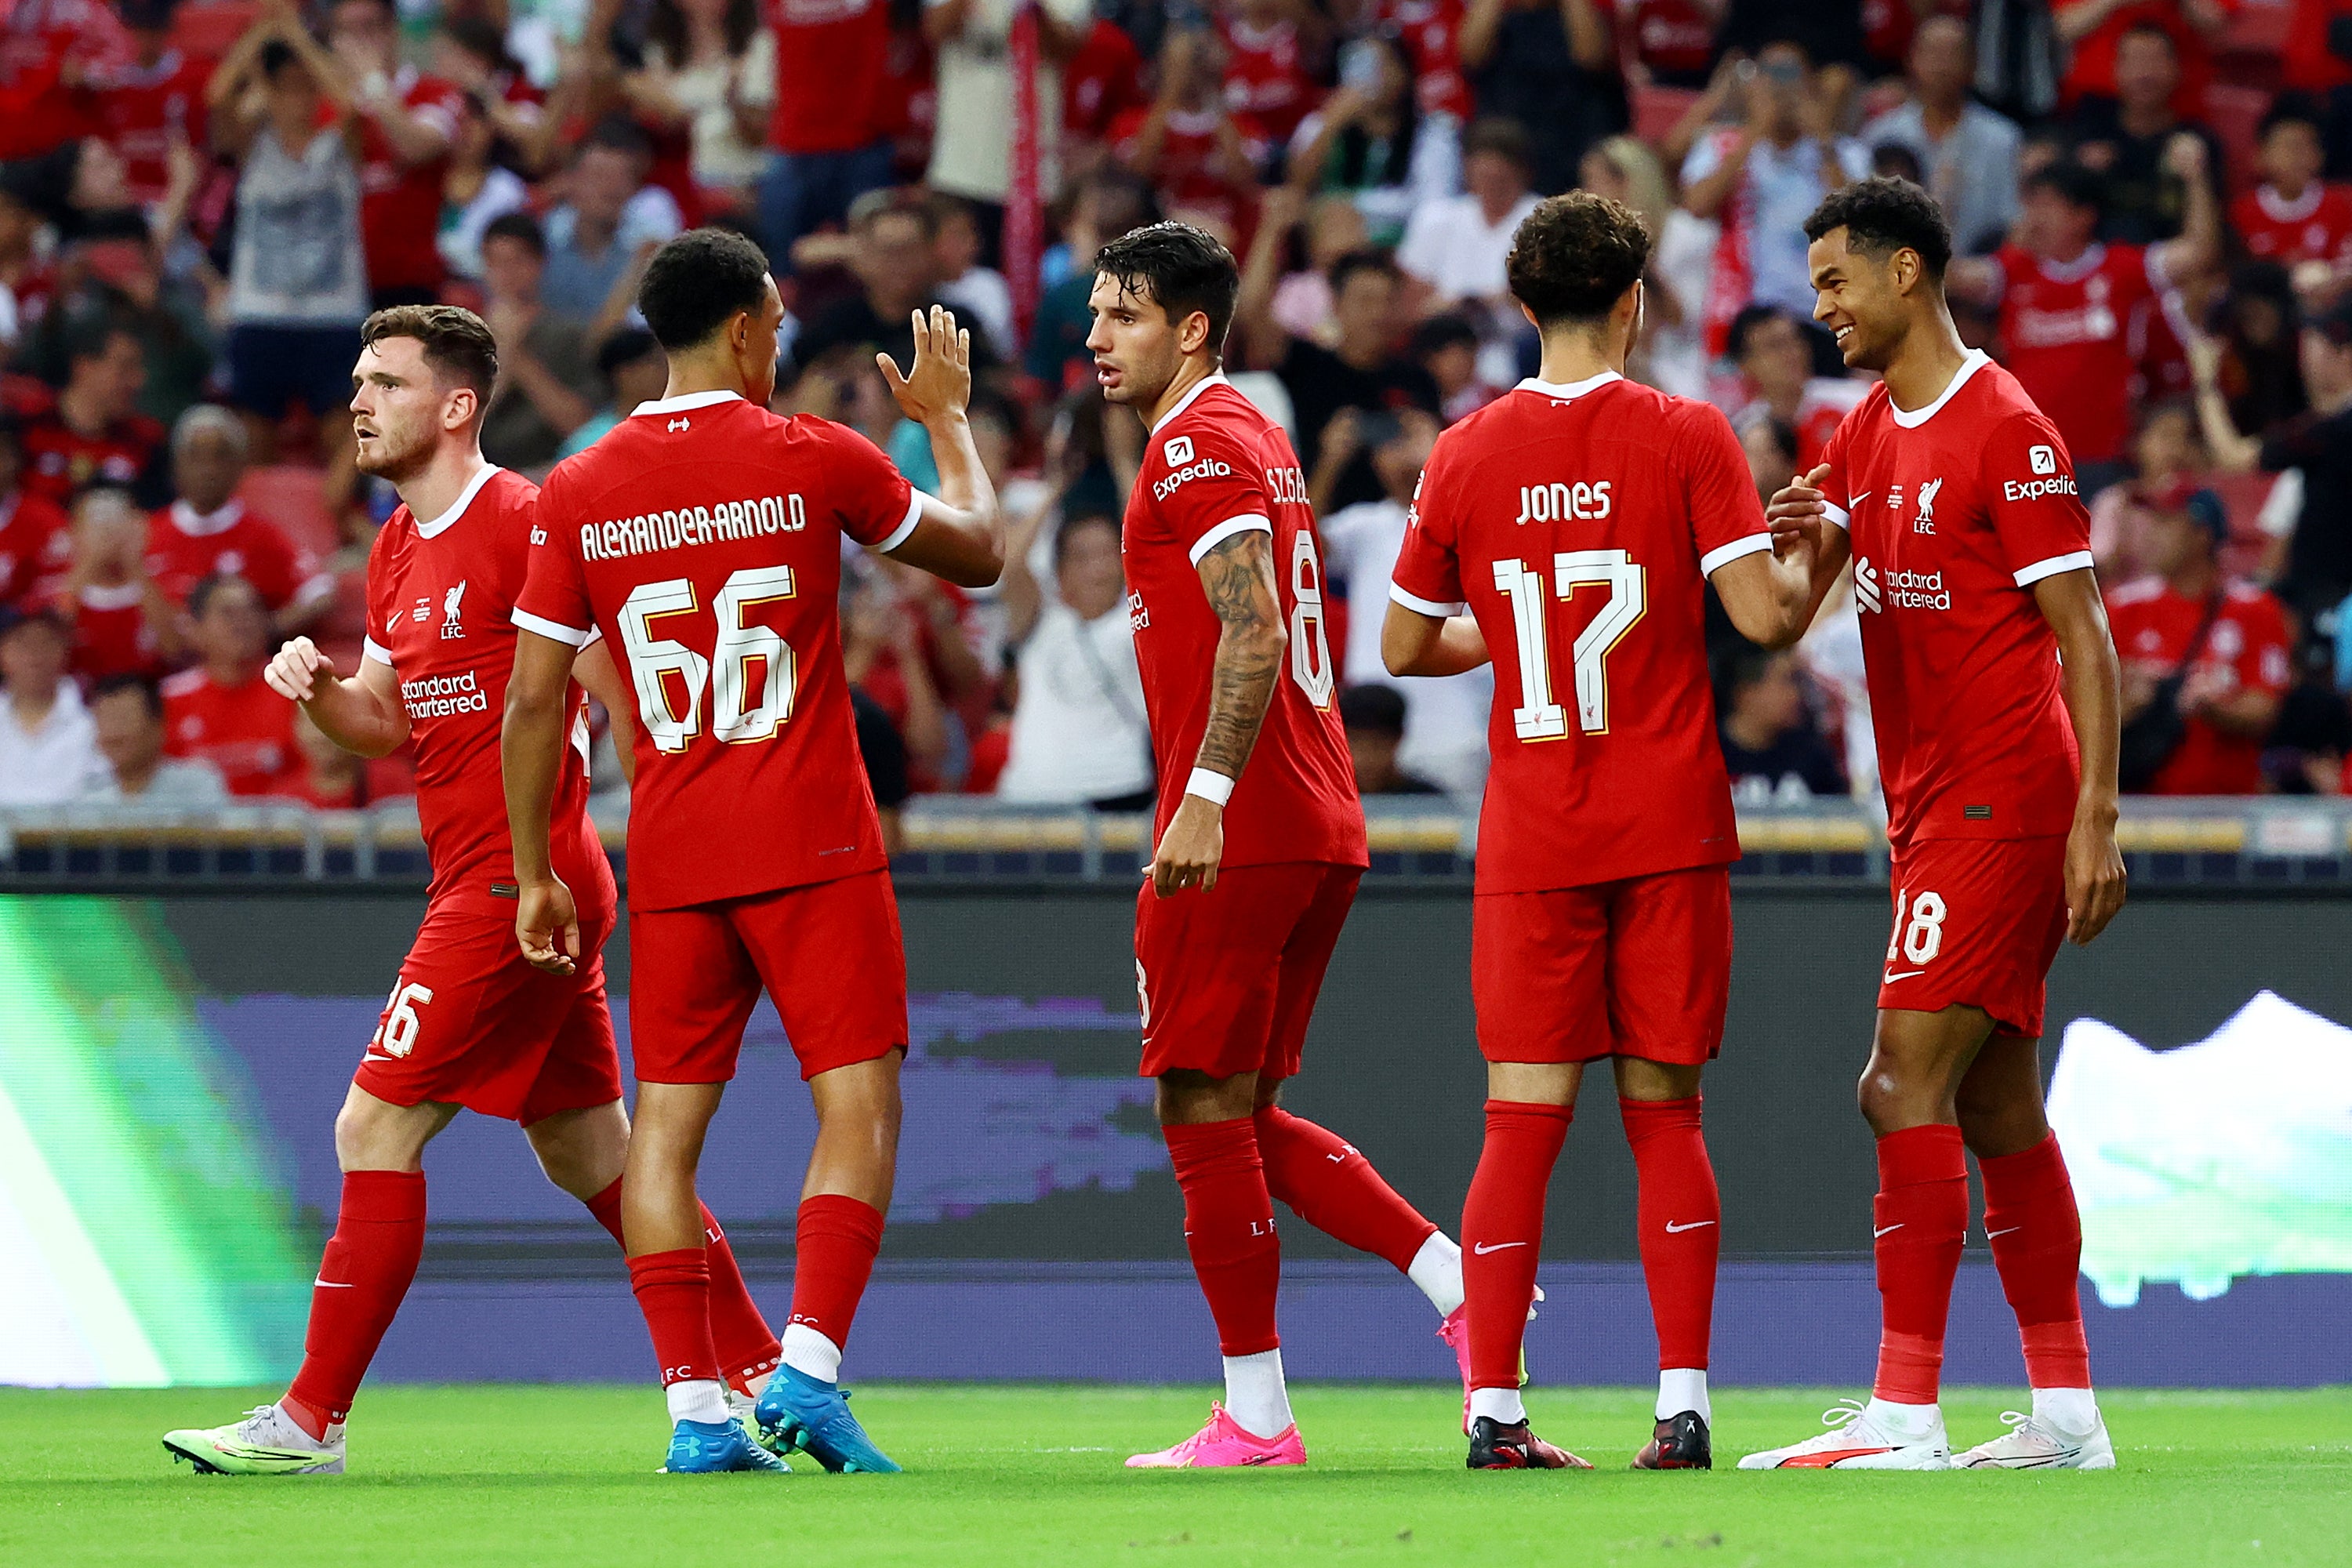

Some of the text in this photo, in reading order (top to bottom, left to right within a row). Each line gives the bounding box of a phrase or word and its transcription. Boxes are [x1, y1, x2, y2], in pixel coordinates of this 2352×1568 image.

[1152, 458, 1231, 502] Expedia
[1516, 481, 1612, 525] JONES
[580, 493, 807, 562] ALEXANDER-ARNOLD
[1291, 529, 1334, 713] 8
[1492, 549, 1648, 744] 17
[401, 670, 477, 700] standard
[616, 564, 798, 757] 66
